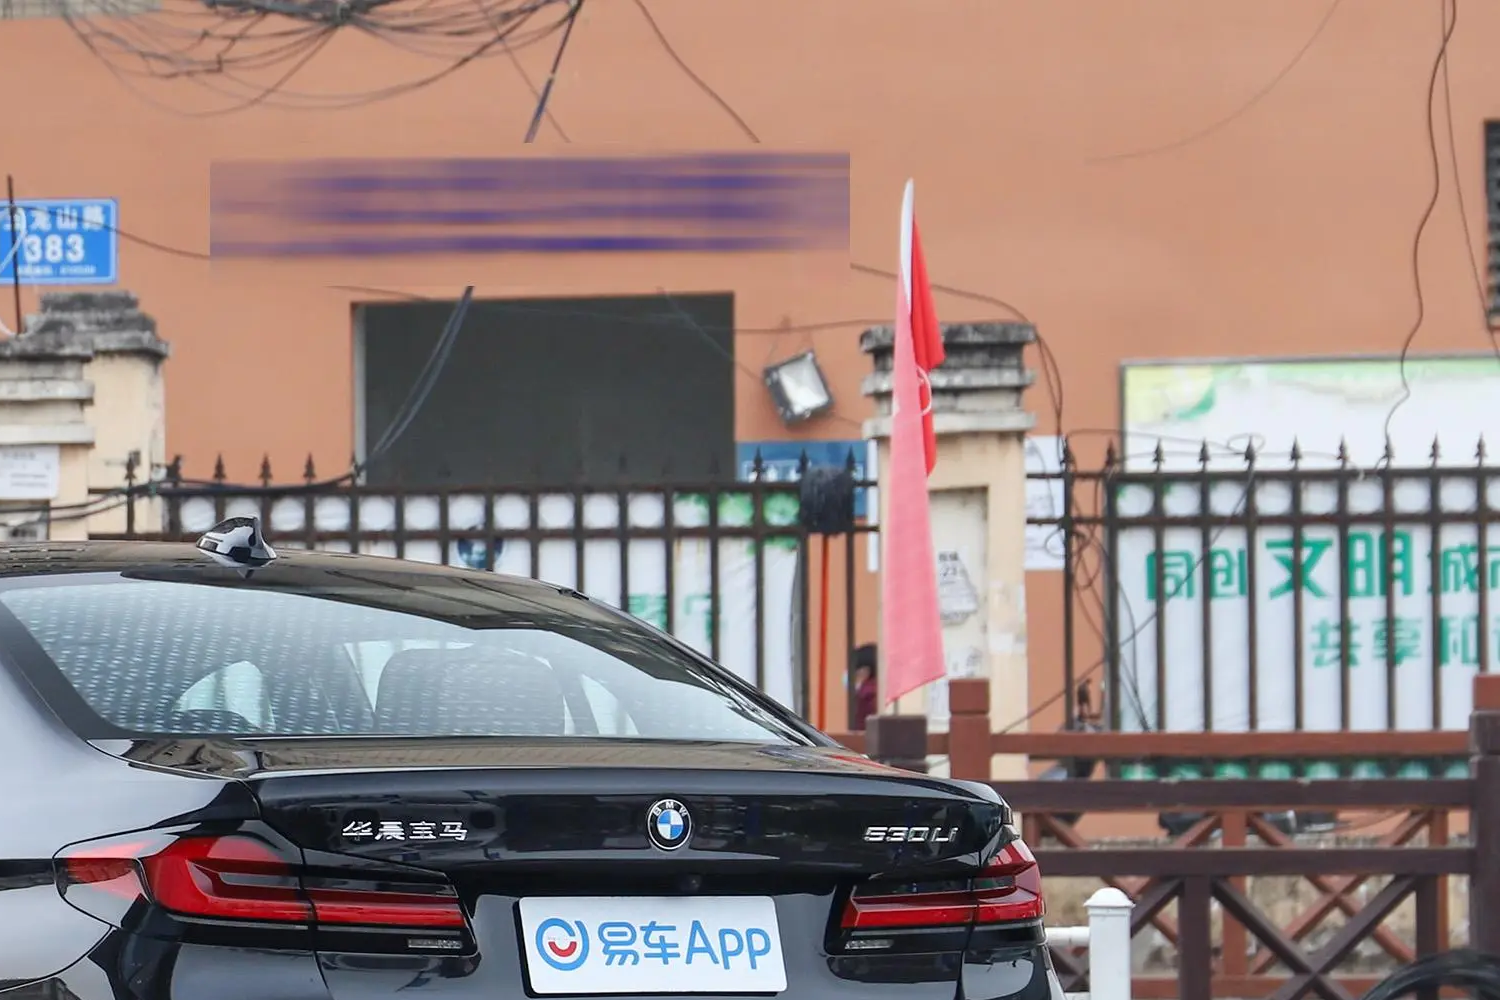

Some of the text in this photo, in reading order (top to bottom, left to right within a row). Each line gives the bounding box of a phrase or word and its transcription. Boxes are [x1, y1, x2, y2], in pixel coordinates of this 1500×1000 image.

[24, 233, 85, 263] 383
[1311, 615, 1500, 668] 共享和
[342, 820, 468, 842] 华晨宝马
[864, 826, 959, 842] 530Li
